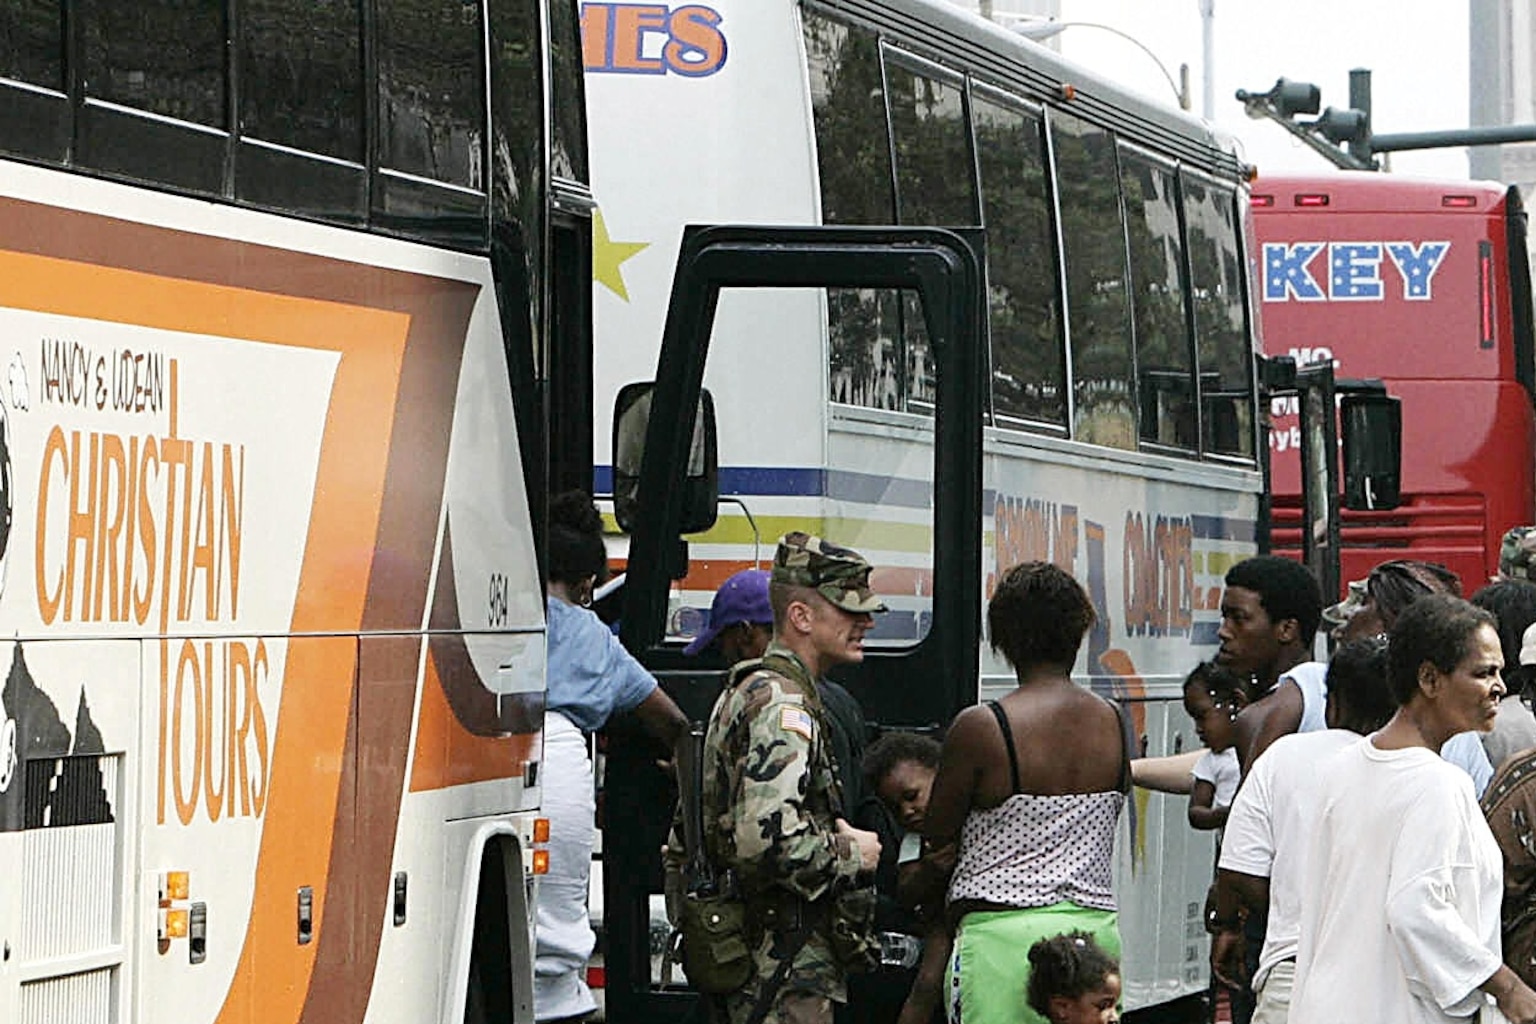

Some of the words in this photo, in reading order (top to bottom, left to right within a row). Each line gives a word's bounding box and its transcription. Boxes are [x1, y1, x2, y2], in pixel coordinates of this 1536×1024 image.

[1262, 240, 1451, 302] KEY
[41, 338, 91, 408] NANCY
[96, 355, 108, 412] &
[35, 359, 244, 634] CHRISTIAN
[488, 573, 508, 627] 964
[157, 637, 268, 826] TOURS
